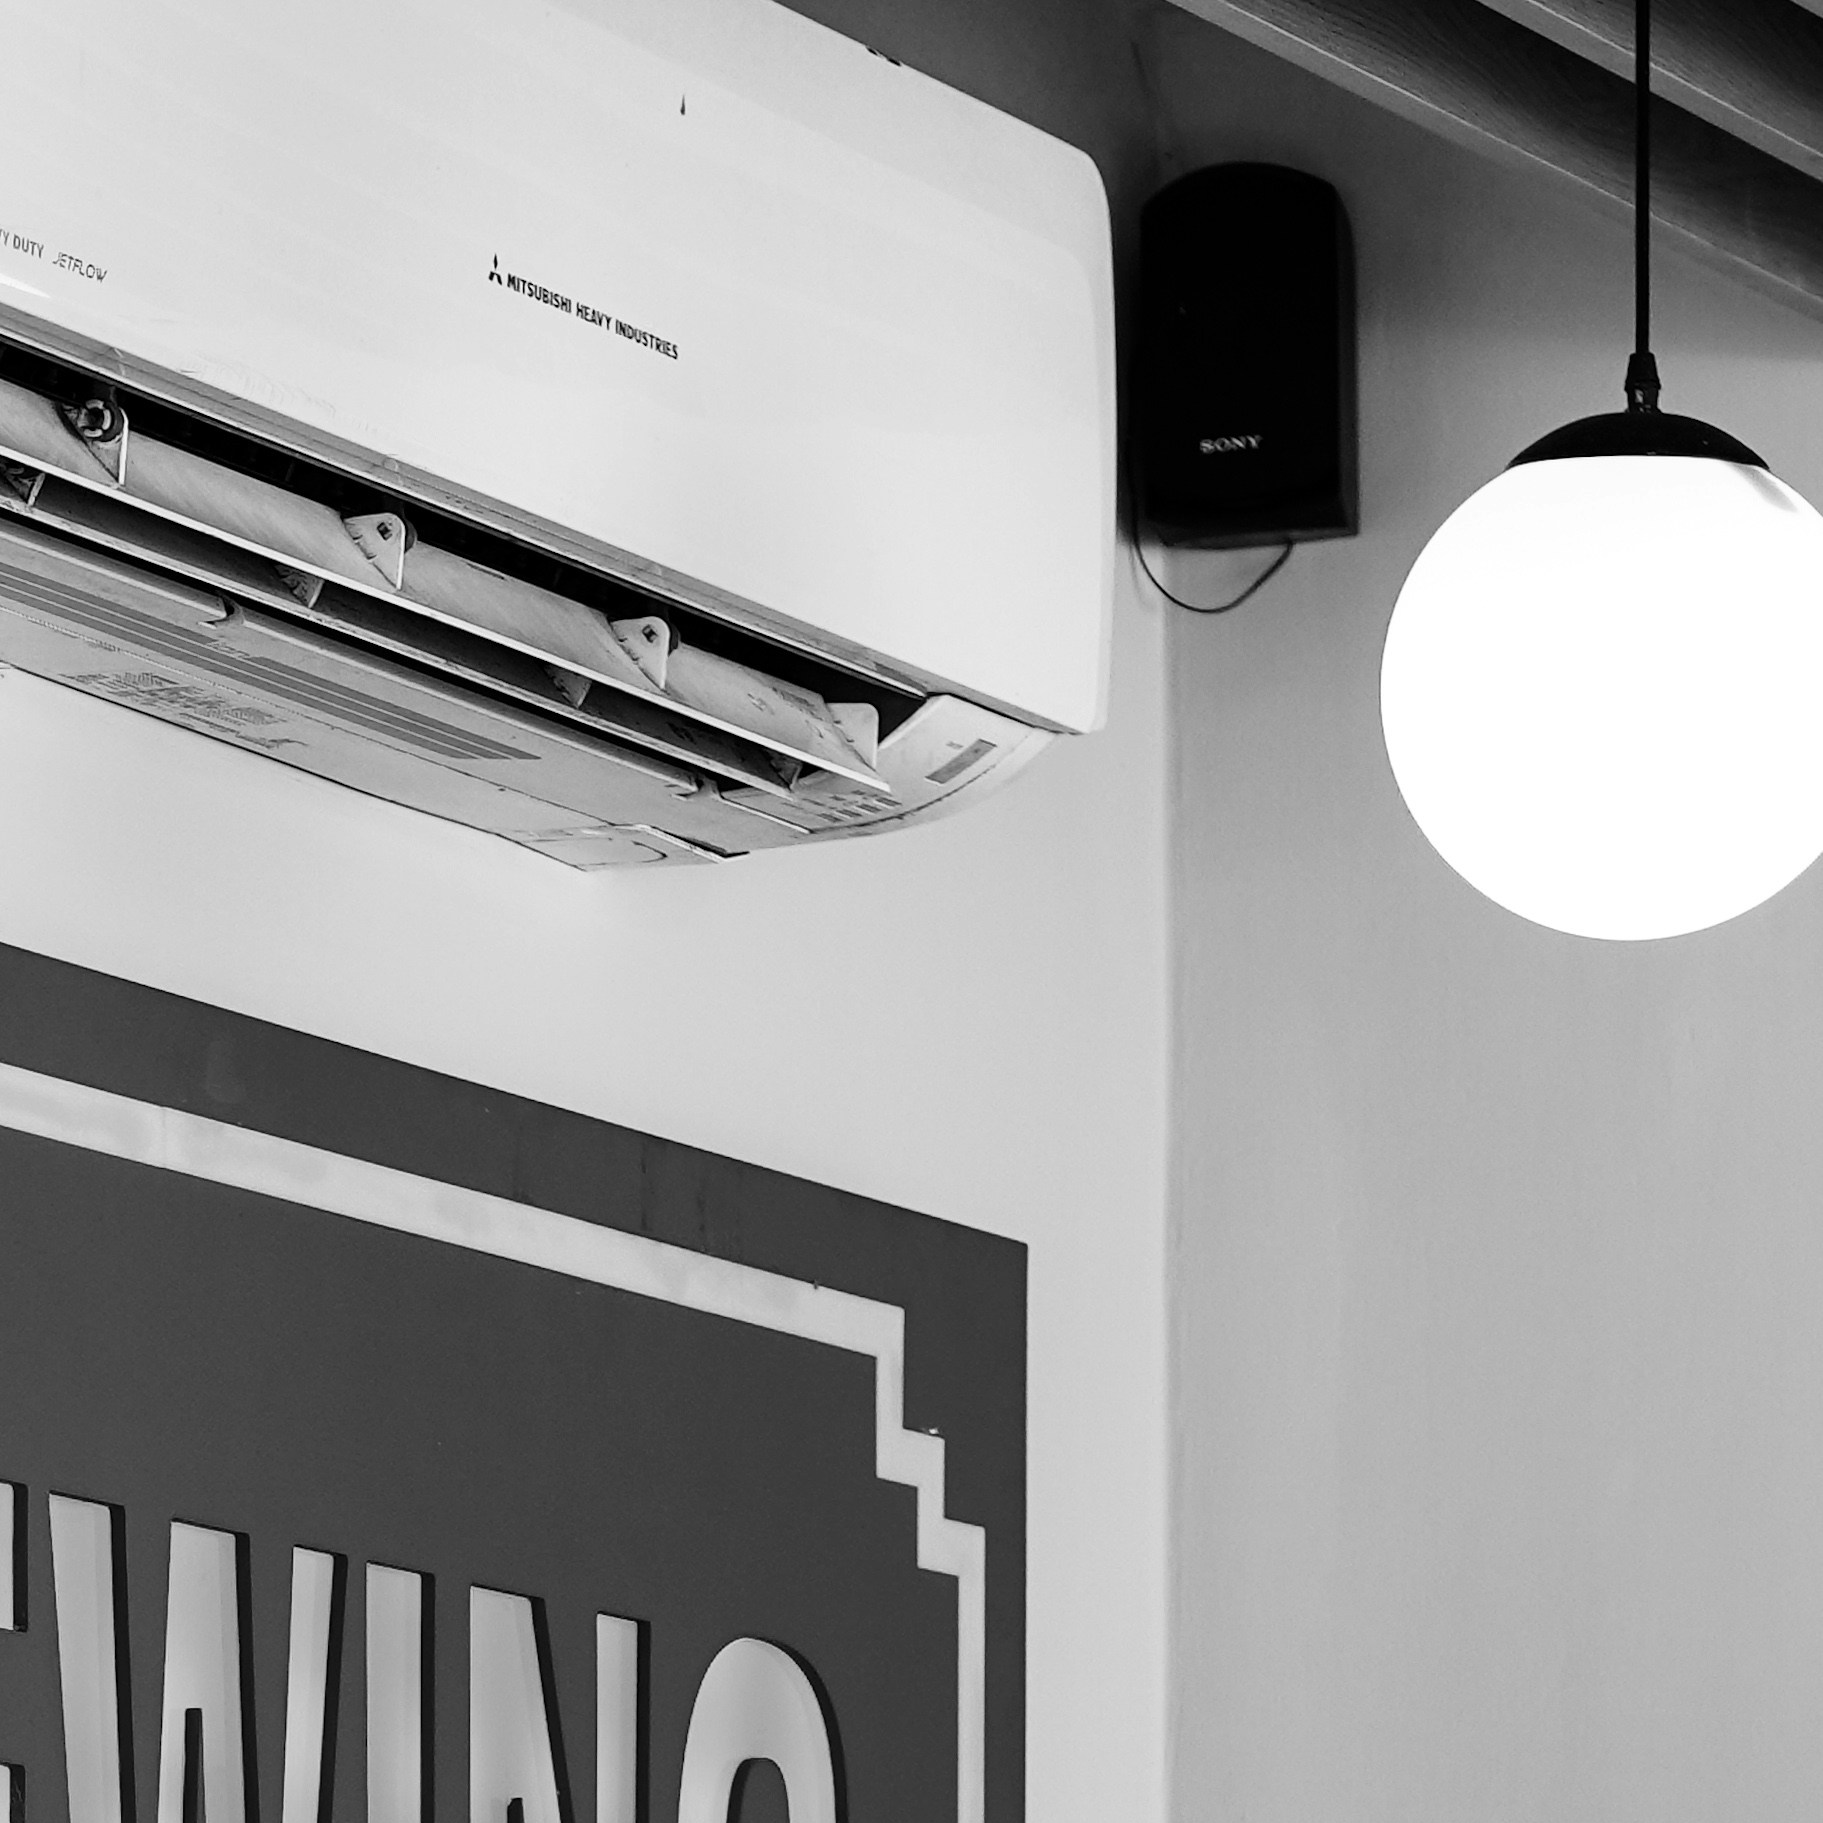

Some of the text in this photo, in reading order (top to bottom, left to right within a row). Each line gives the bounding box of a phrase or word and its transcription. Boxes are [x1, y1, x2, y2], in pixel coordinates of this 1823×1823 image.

[13, 233, 44, 259] DUTY
[52, 251, 107, 282] JETFLOW
[507, 272, 678, 359] MITSUBISHI HEAVY INDUSTRIES
[1200, 434, 1263, 454] SONY
